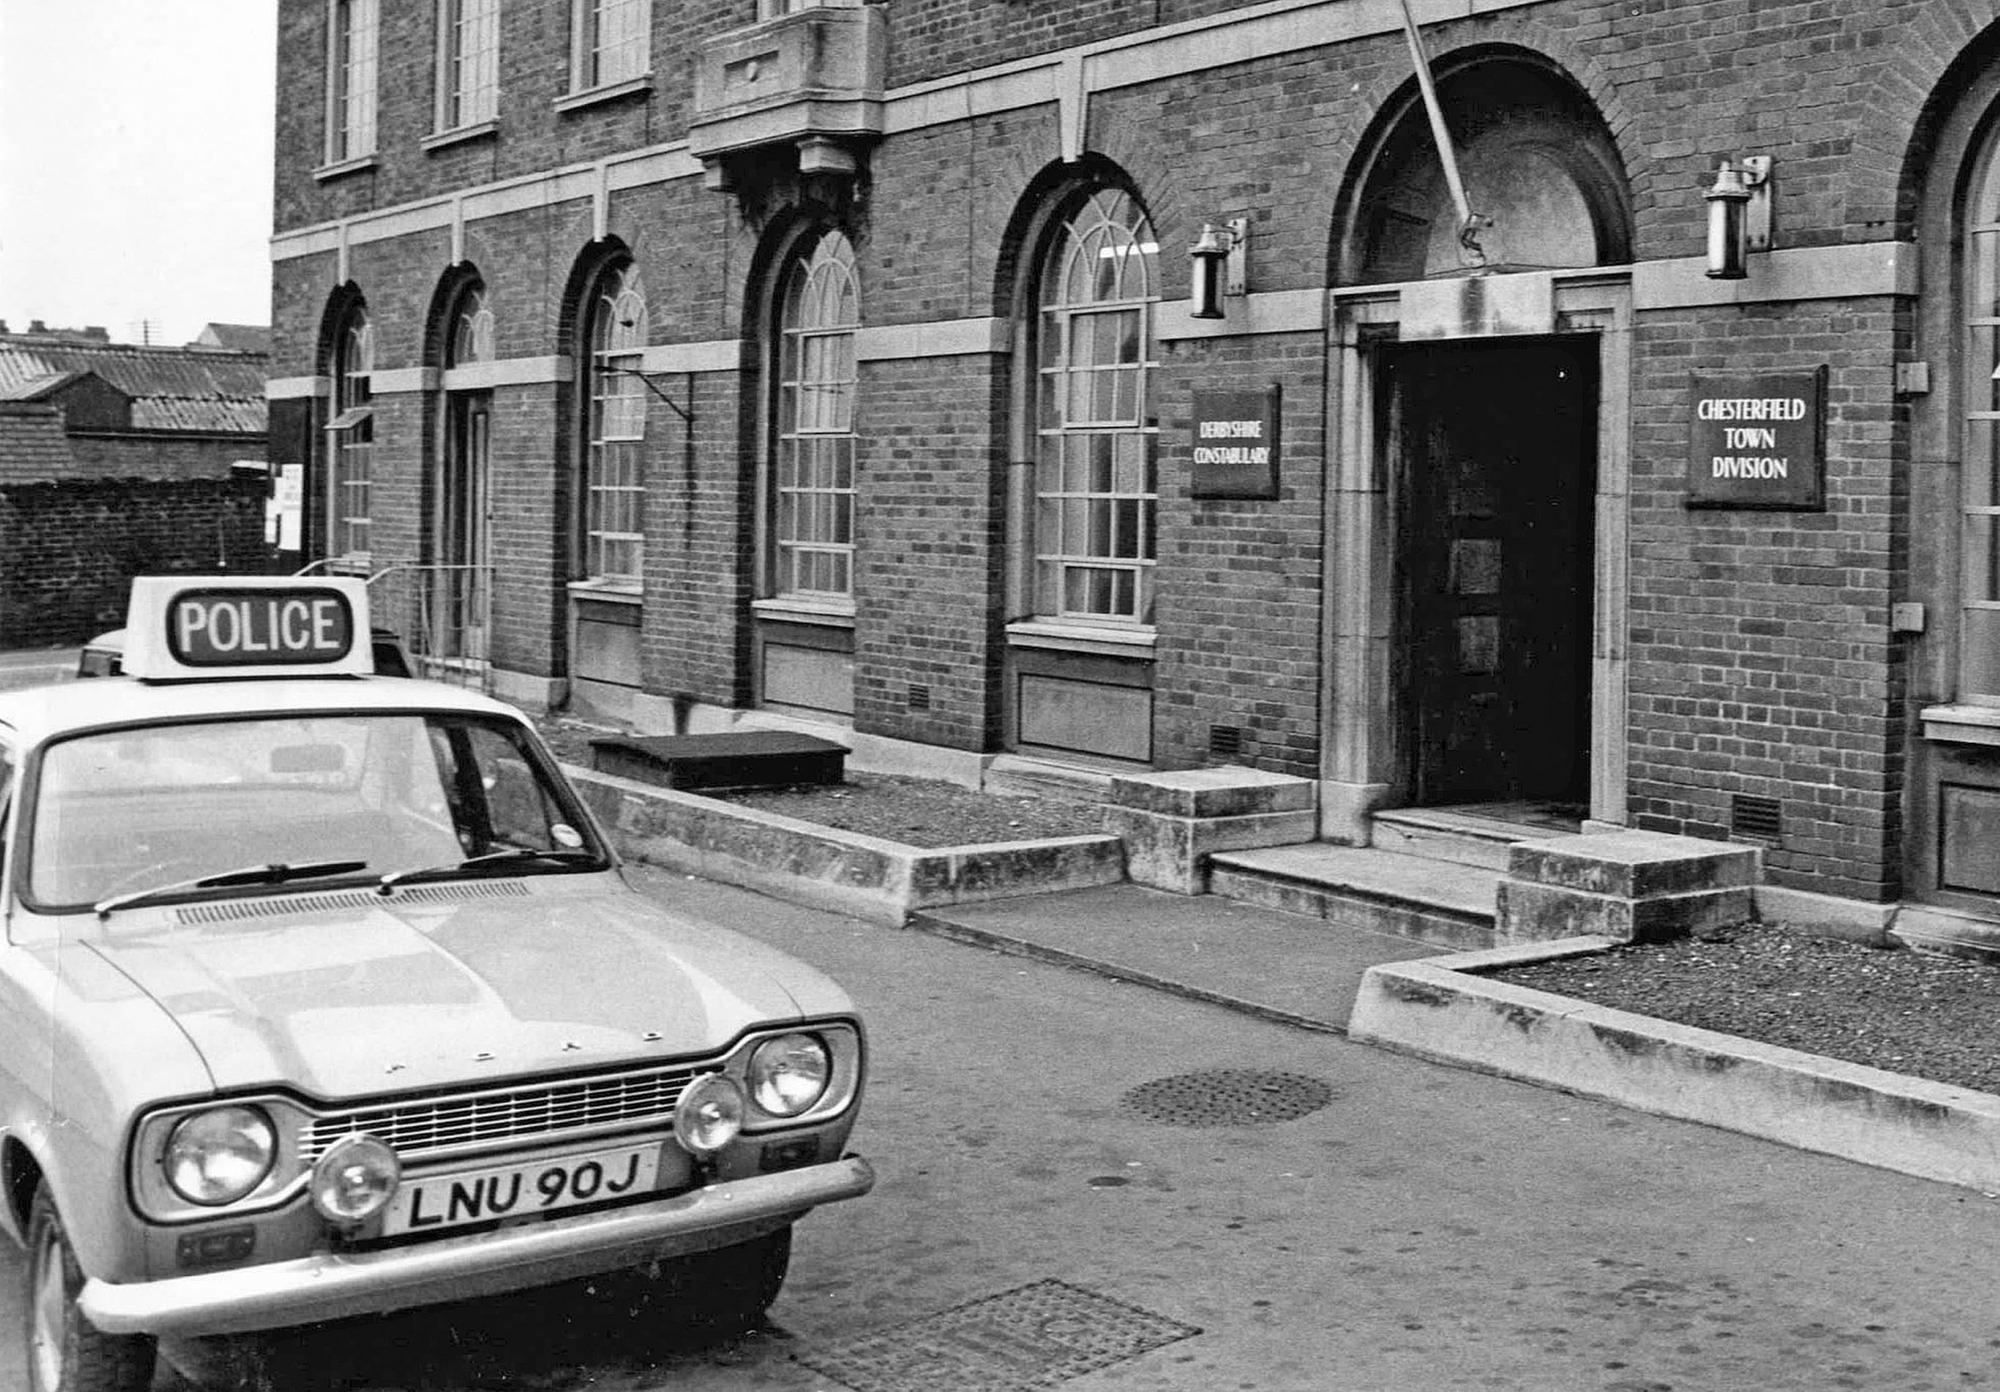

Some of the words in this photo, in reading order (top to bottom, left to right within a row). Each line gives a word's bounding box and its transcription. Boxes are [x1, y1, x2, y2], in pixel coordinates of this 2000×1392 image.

[1698, 398, 1806, 420] CHESTERFIELD
[1200, 420, 1263, 438] DERBYSHIRE
[1723, 427, 1776, 449] TOWN
[1193, 446, 1271, 464] CONSTABULARY
[1712, 456, 1788, 479] DIVISION
[178, 600, 341, 652] POLICE
[408, 1172, 522, 1228] LNU
[536, 1153, 640, 1207] 90J
